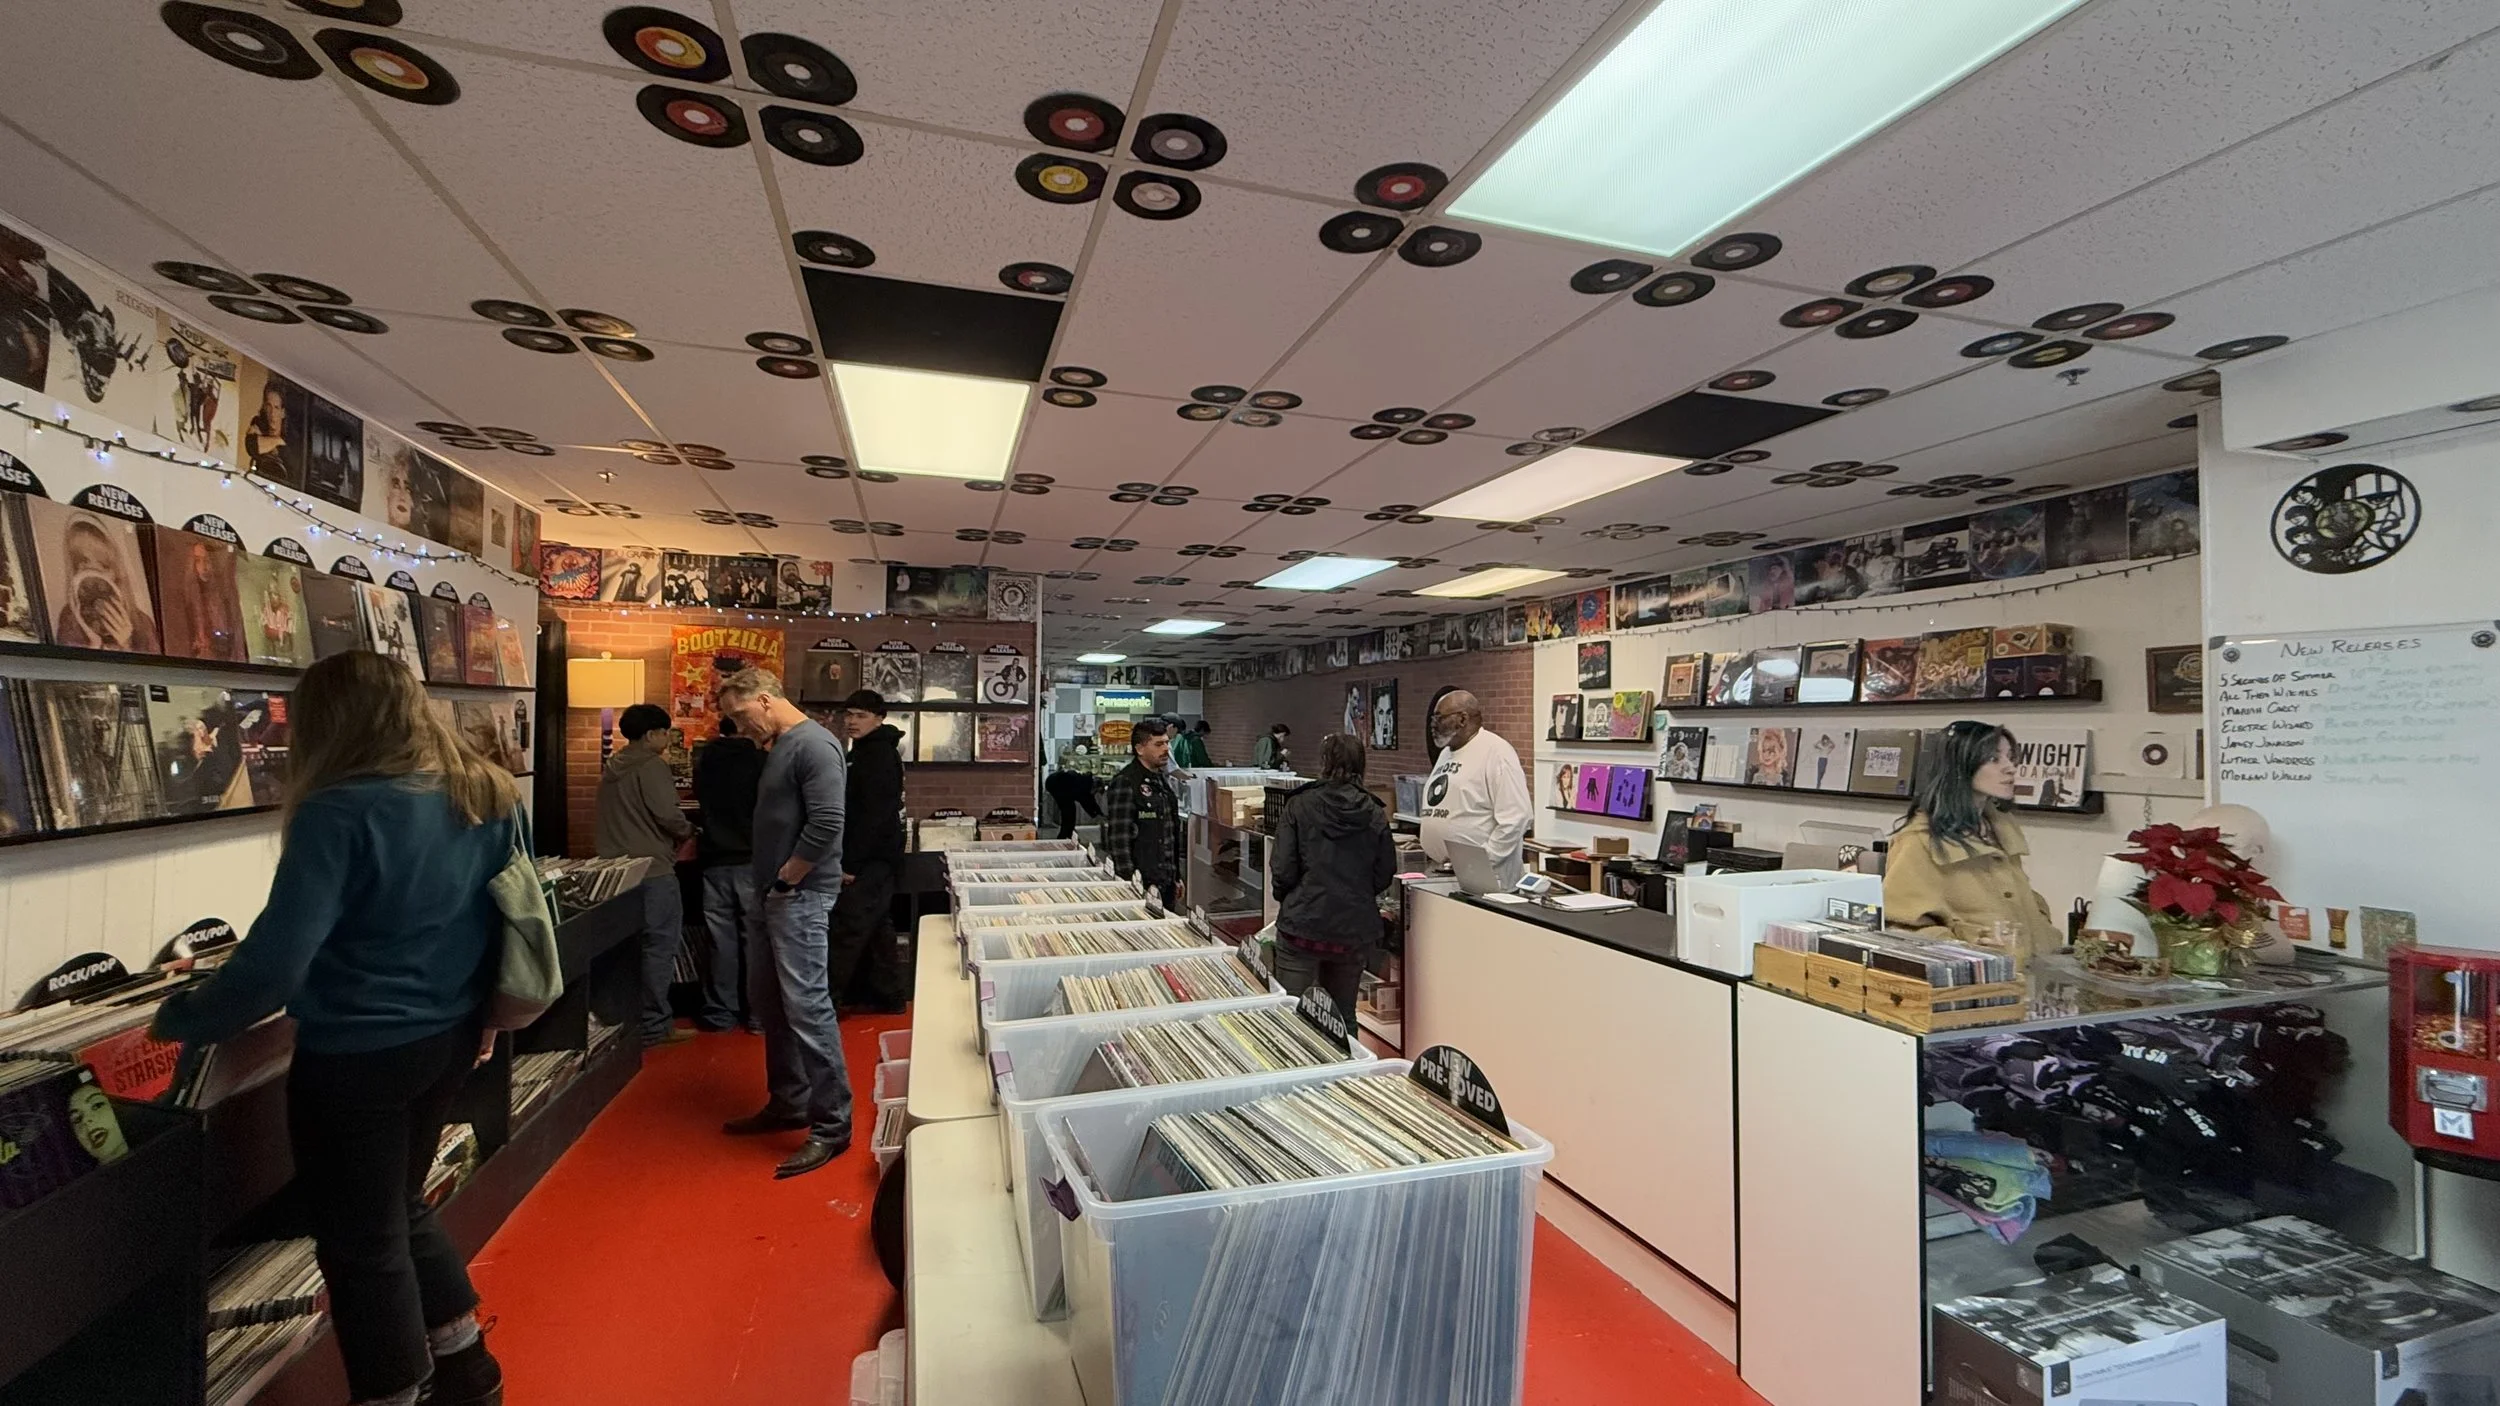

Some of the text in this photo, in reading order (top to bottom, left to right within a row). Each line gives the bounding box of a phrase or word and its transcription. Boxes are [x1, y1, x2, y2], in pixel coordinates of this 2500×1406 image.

[0, 468, 31, 487] ASES
[100, 484, 129, 503] NEW
[88, 492, 144, 519] RELEASES
[203, 514, 226, 530] NEW
[193, 521, 237, 543] RELEASES
[273, 543, 308, 564] RELEASES
[280, 537, 299, 551] NEW
[677, 627, 779, 658] BOOTZILLA
[2280, 638, 2422, 658] NEW RELEASES
[2219, 673, 2228, 687] 5
[2231, 674, 2269, 686] SECONDS
[2272, 674, 2286, 682] OF
[2291, 671, 2336, 682] SUMMER
[1096, 695, 1151, 707] Panasonic
[2220, 691, 2239, 701] ALL
[2222, 705, 2262, 717] MARIAH
[2267, 702, 2299, 713] CAREY
[2221, 719, 2268, 733] ELECTRIC
[2272, 720, 2314, 730] WIZARD
[2018, 742, 2086, 767] WIGHT
[2220, 752, 2260, 765] LUTHER
[2264, 753, 2315, 766] VANDROSS
[2020, 765, 2076, 780] OAKM
[2221, 769, 2268, 781] MORGAN
[2272, 771, 2312, 781] WALLEN
[180, 924, 229, 946] ROCK/POP
[49, 957, 117, 991] ROCK/POP
[1312, 987, 1332, 1008] NEW
[1301, 995, 1344, 1039] PRE-LOVED
[1439, 1046, 1472, 1079] NEW
[1420, 1056, 1496, 1112] PRE-LOVED
